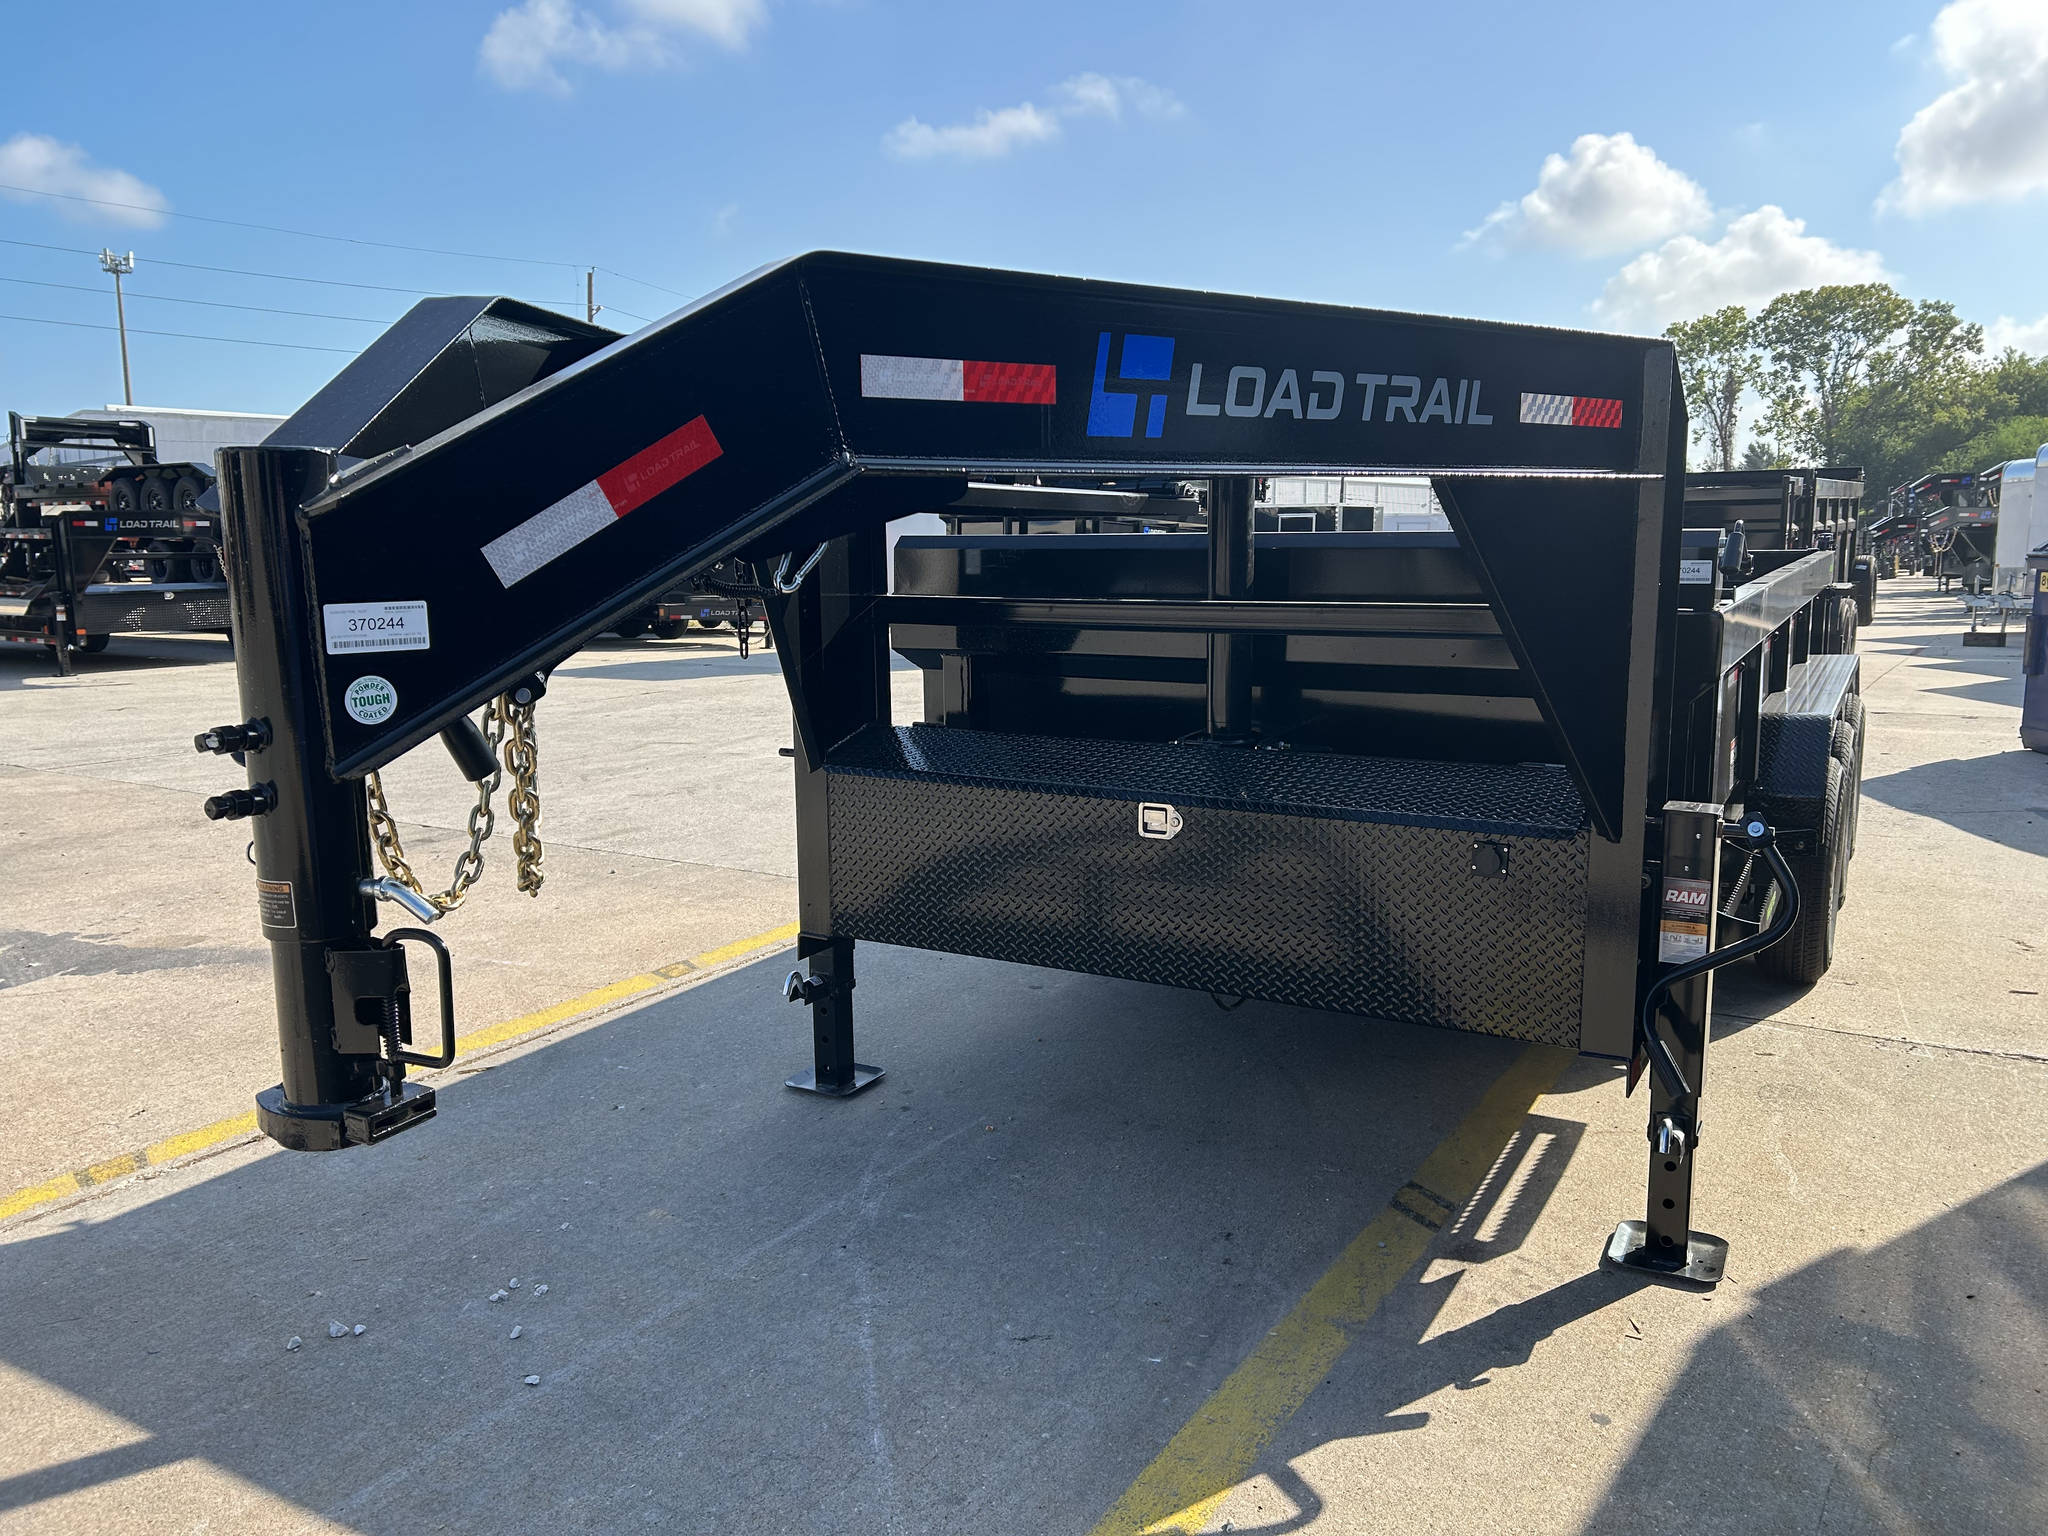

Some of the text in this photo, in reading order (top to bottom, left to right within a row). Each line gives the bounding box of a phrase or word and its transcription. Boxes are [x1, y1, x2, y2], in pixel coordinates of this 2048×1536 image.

[1185, 362, 1493, 425] LOAD TRAIL
[640, 440, 701, 481] LOAD TRAIL
[119, 520, 179, 528] LOAD TRAIL
[1680, 566, 1700, 574] 0244
[348, 617, 405, 631] 370244
[354, 682, 385, 695] POWDER
[351, 692, 390, 708] TOUGH
[358, 706, 388, 719] COATED
[1665, 889, 1708, 905] RAM
